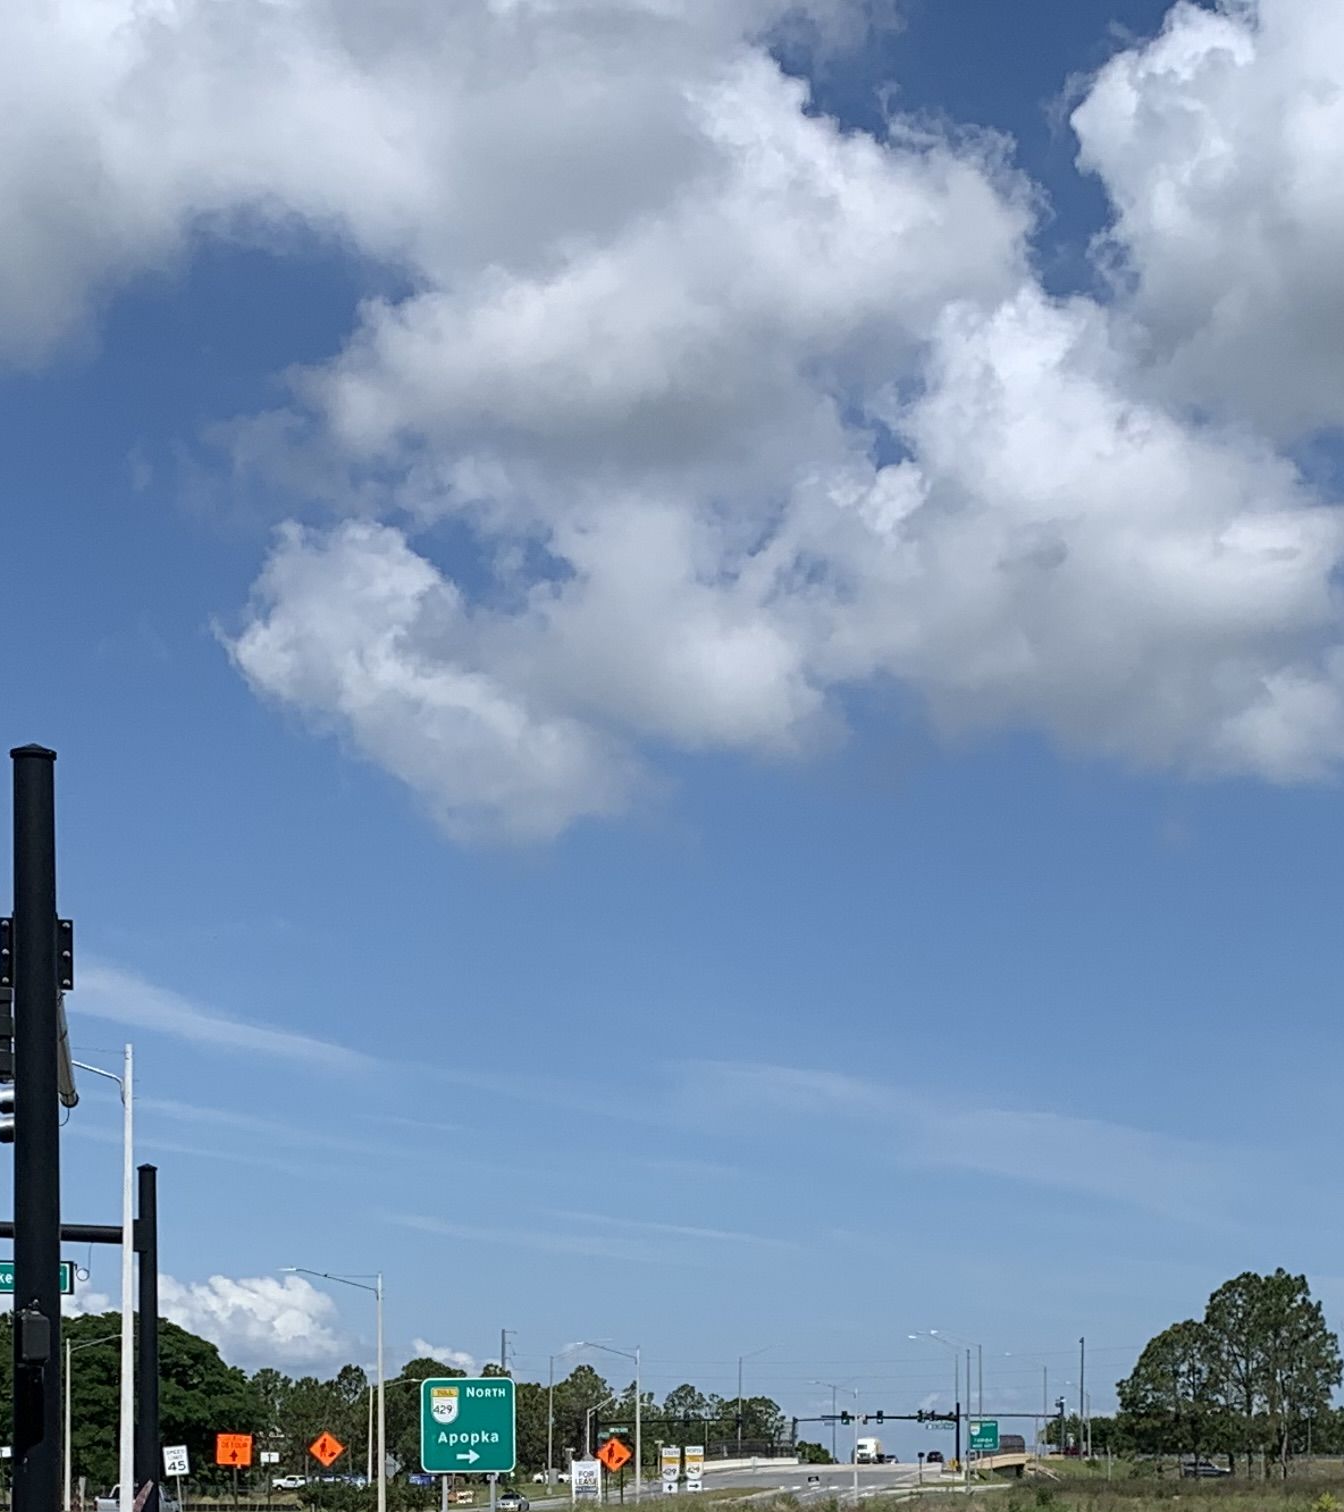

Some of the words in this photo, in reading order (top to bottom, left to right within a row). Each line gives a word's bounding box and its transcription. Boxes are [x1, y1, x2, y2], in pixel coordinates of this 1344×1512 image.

[466, 1387, 506, 1398] NORTH
[433, 1404, 453, 1415] 429
[437, 1431, 499, 1446] Apopka
[168, 1461, 186, 1471] 45
